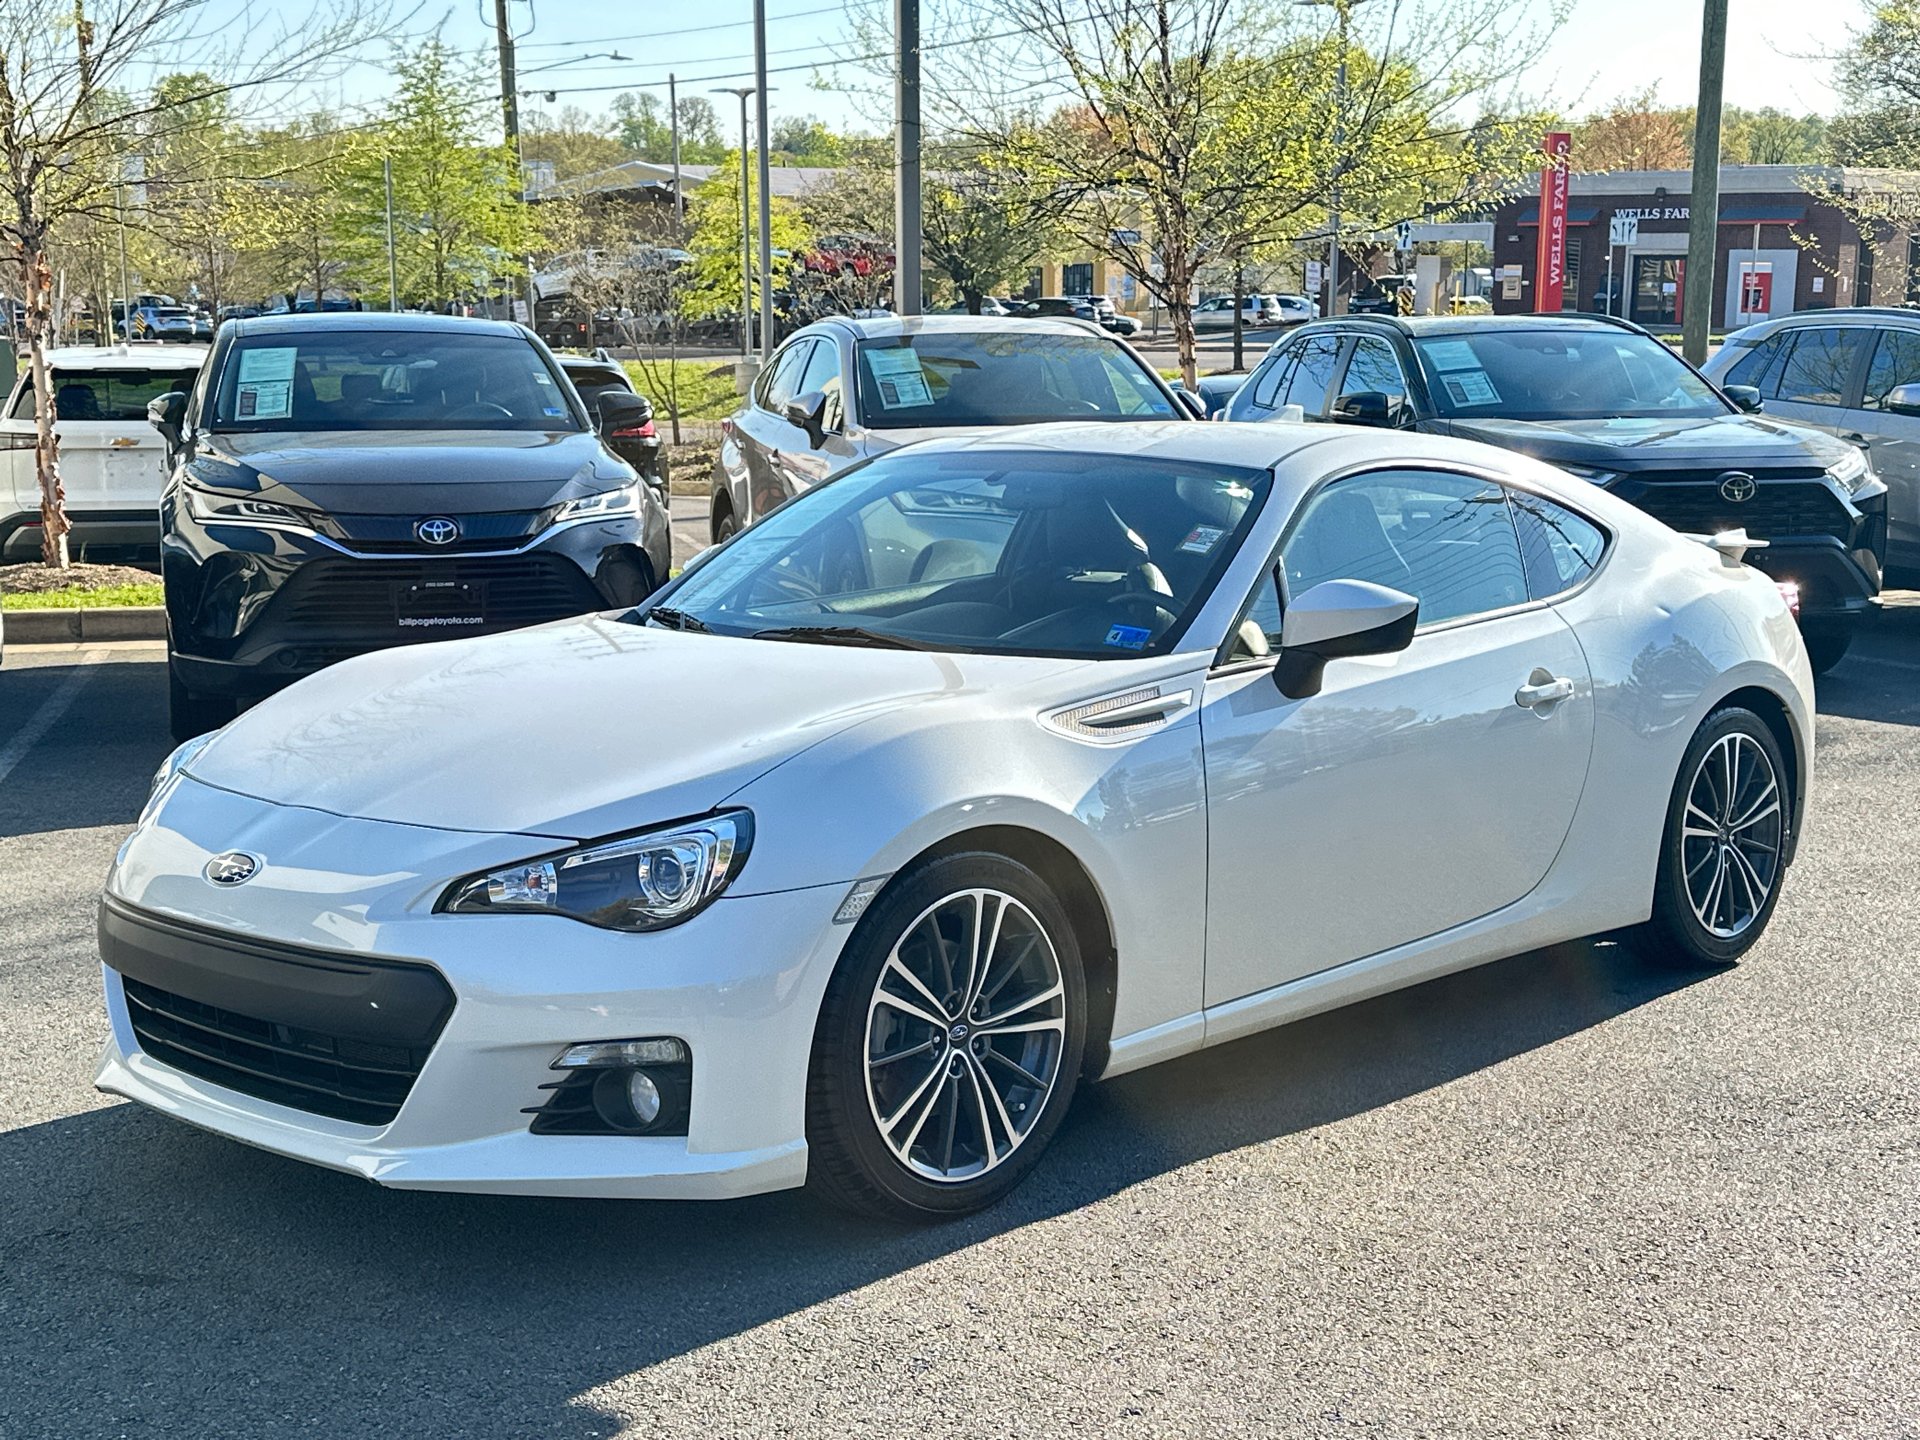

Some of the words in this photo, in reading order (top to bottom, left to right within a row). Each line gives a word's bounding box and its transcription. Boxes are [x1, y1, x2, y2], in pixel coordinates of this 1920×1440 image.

[1615, 208, 1660, 219] WELLS
[1664, 207, 1690, 219] FAR
[1550, 216, 1563, 286] WELLS
[398, 616, 483, 626] billpagetoyota.com
[1111, 631, 1121, 641] 4
